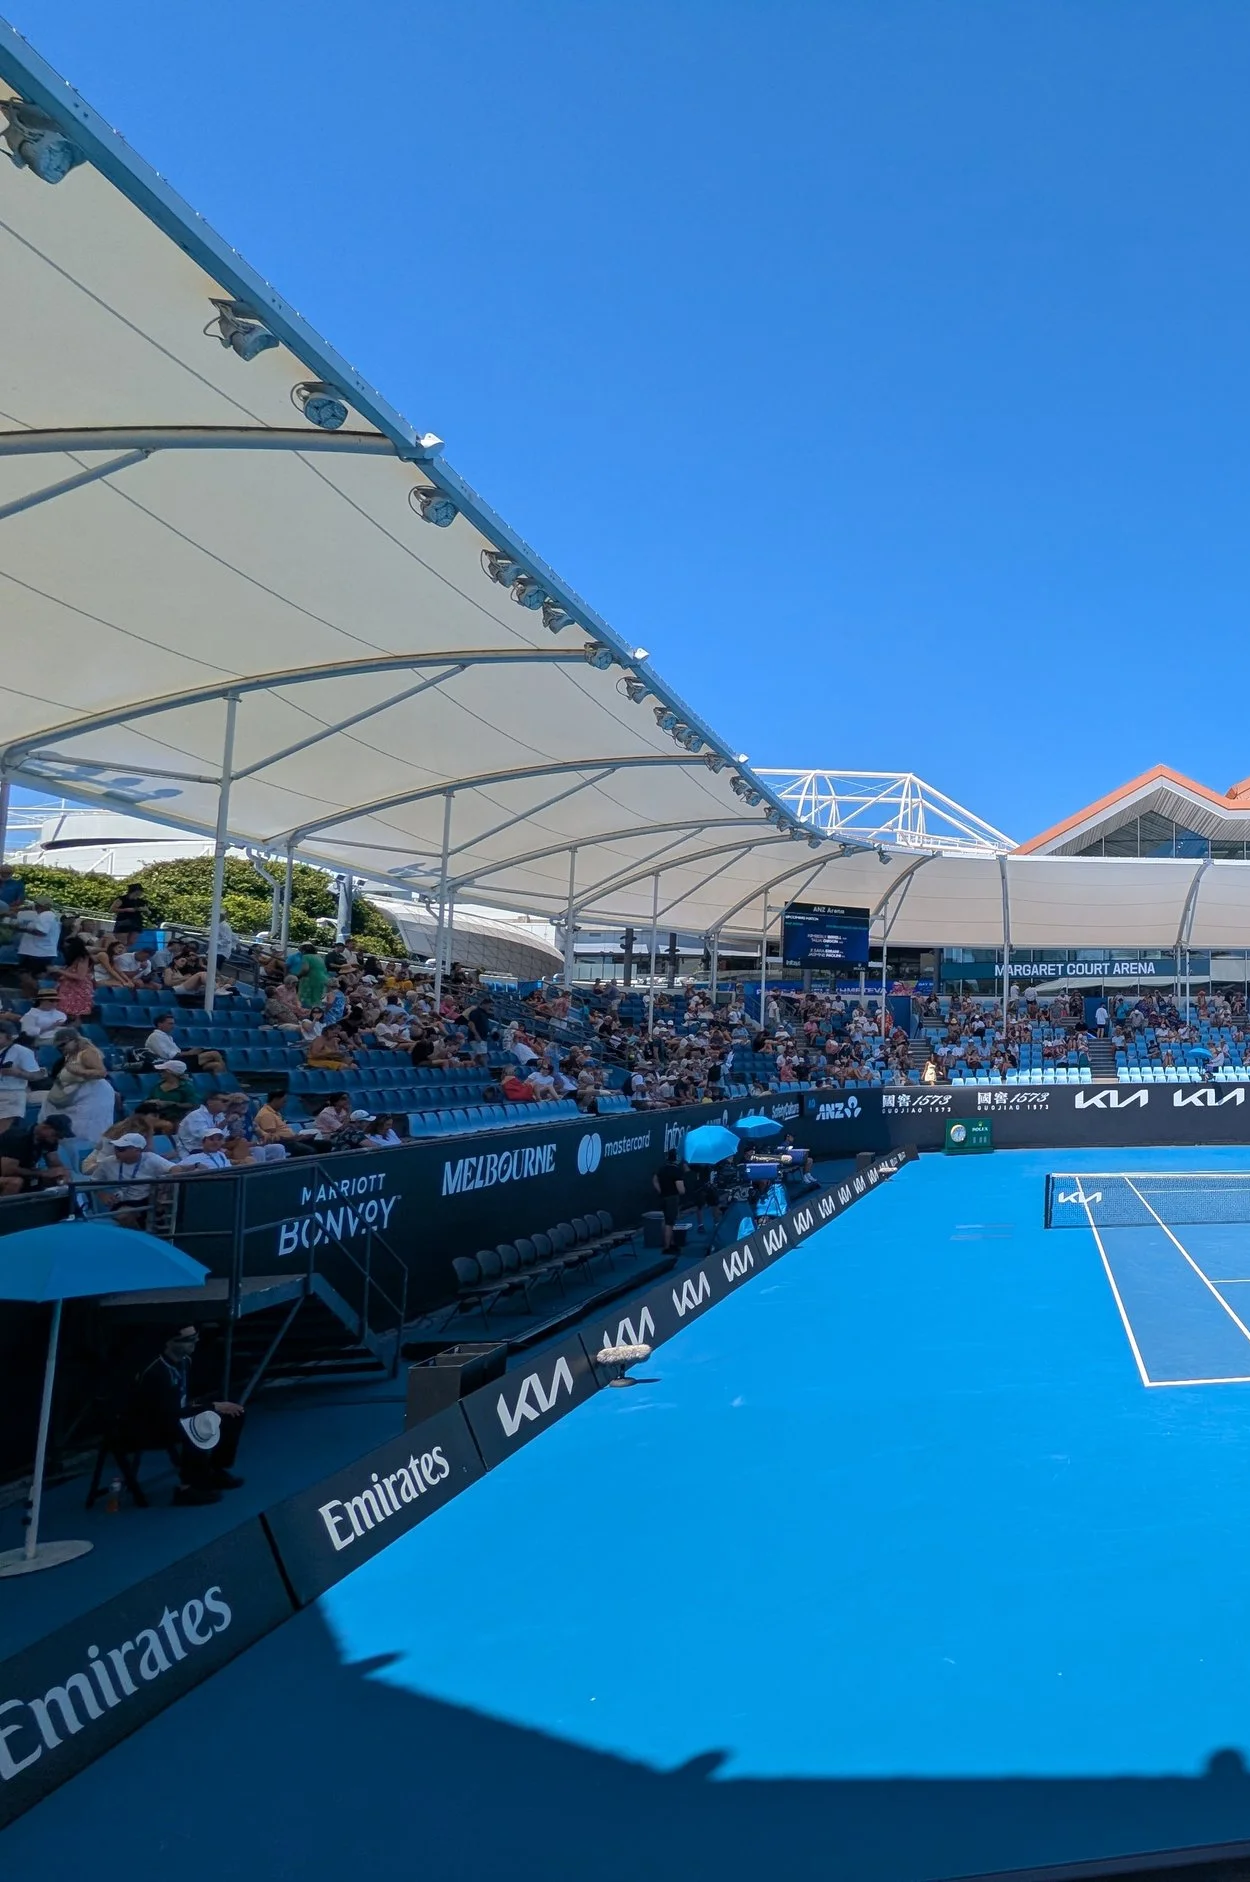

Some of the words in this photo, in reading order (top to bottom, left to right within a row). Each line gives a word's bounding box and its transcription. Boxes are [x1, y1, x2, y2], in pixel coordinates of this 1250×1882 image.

[994, 963, 1065, 977] MARGARET
[1066, 962, 1111, 975] COURT
[1112, 962, 1156, 975] ARENA
[816, 1103, 844, 1120] ANZ
[1075, 1090, 1149, 1108] KIA
[1173, 1088, 1245, 1107] KIA
[604, 1131, 651, 1157] mastercard
[441, 1143, 557, 1196] MELBOURNE
[301, 1173, 386, 1206] MARRIOTT
[1058, 1191, 1102, 1203] KIA
[793, 1208, 814, 1235] KIA
[818, 1195, 835, 1219] KIA
[278, 1195, 398, 1256] BONVOY
[763, 1224, 788, 1255] KIA
[722, 1244, 754, 1282] KIA
[672, 1271, 711, 1317] KIA
[496, 1356, 574, 1437] KIA
[318, 1444, 450, 1551] Emirates
[0, 1584, 233, 1782] Emirates
